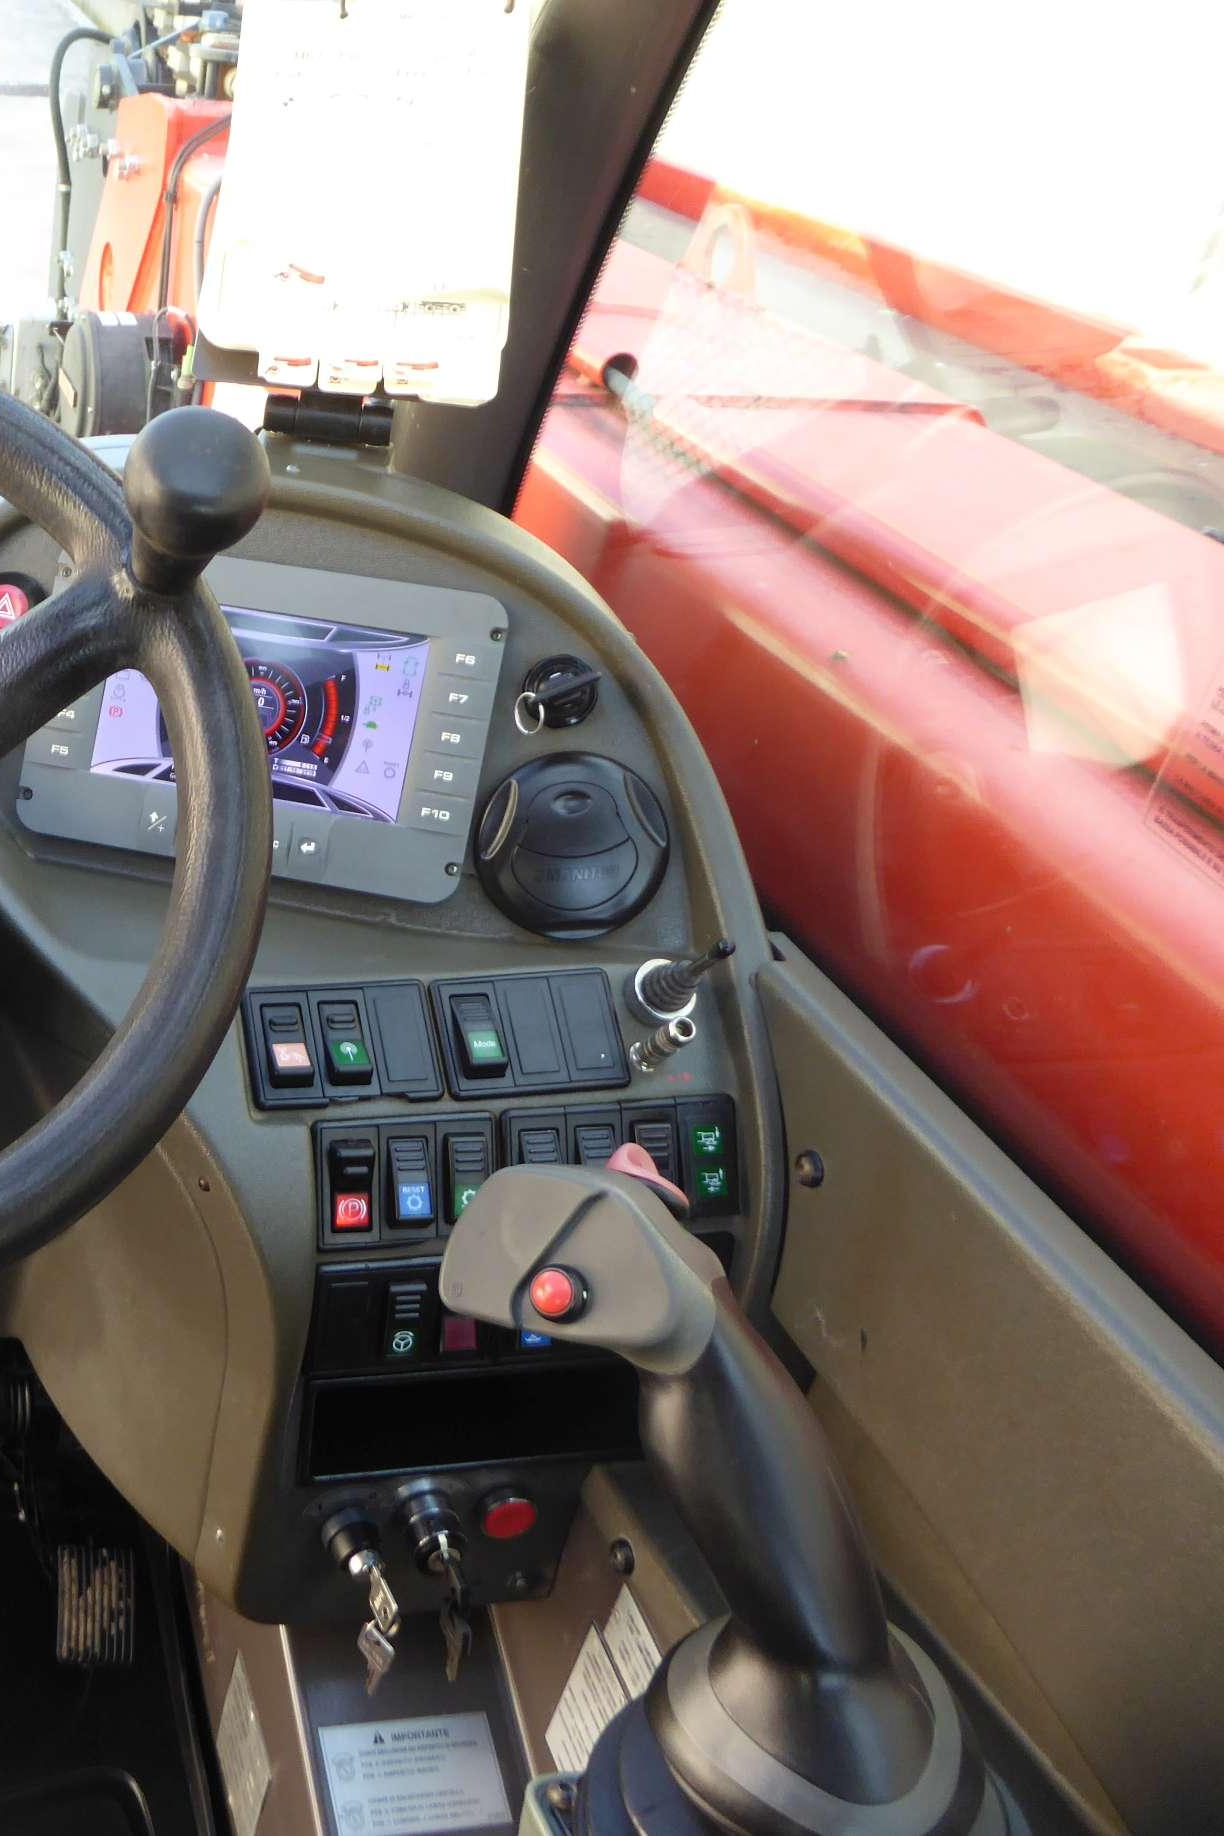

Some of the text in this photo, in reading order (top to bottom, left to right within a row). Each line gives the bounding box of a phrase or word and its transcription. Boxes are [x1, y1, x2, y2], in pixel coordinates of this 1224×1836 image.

[455, 652, 476, 666] F6
[448, 691, 469, 704] F7
[57, 708, 75, 719] F4
[440, 731, 461, 744] F8
[50, 743, 69, 755] F5
[433, 769, 454, 782] F9
[420, 807, 451, 822] F10
[402, 1185, 424, 1193] RESET
[390, 1727, 451, 1743] IMPORTANTE
